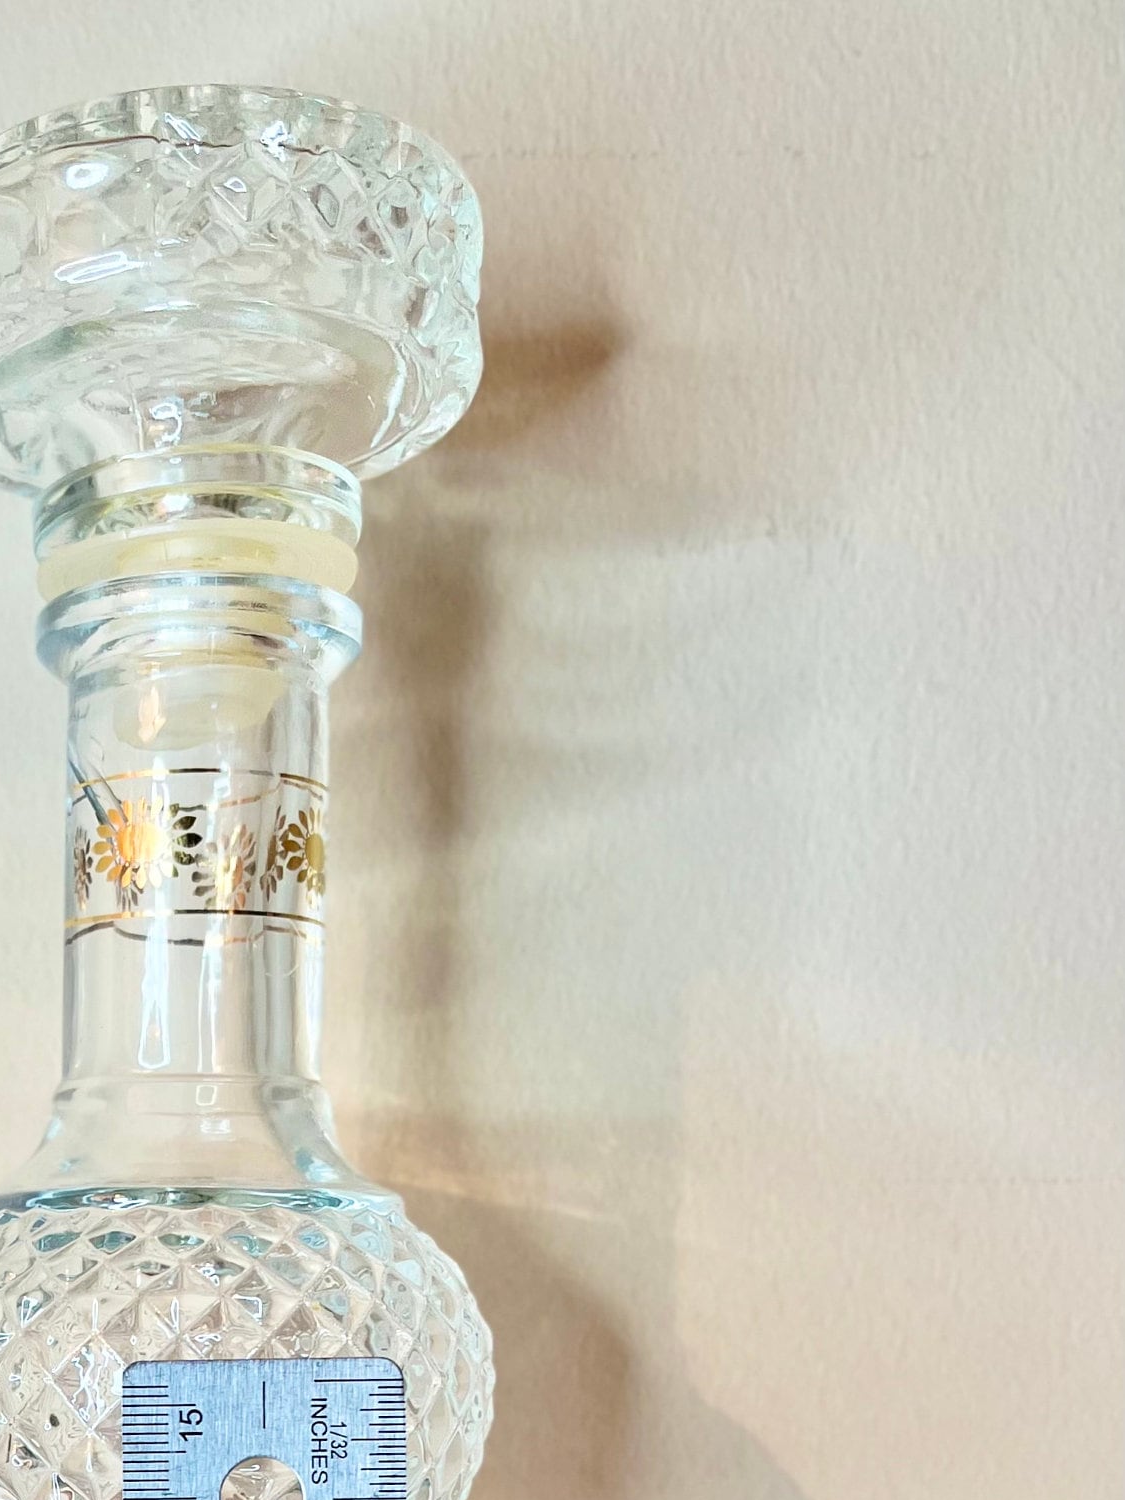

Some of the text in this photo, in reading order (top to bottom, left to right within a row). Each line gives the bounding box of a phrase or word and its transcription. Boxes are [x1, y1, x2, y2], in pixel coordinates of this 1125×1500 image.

[179, 1408, 203, 1441] 15
[311, 1397, 328, 1485] INCHES
[330, 1421, 348, 1459] 1/32
